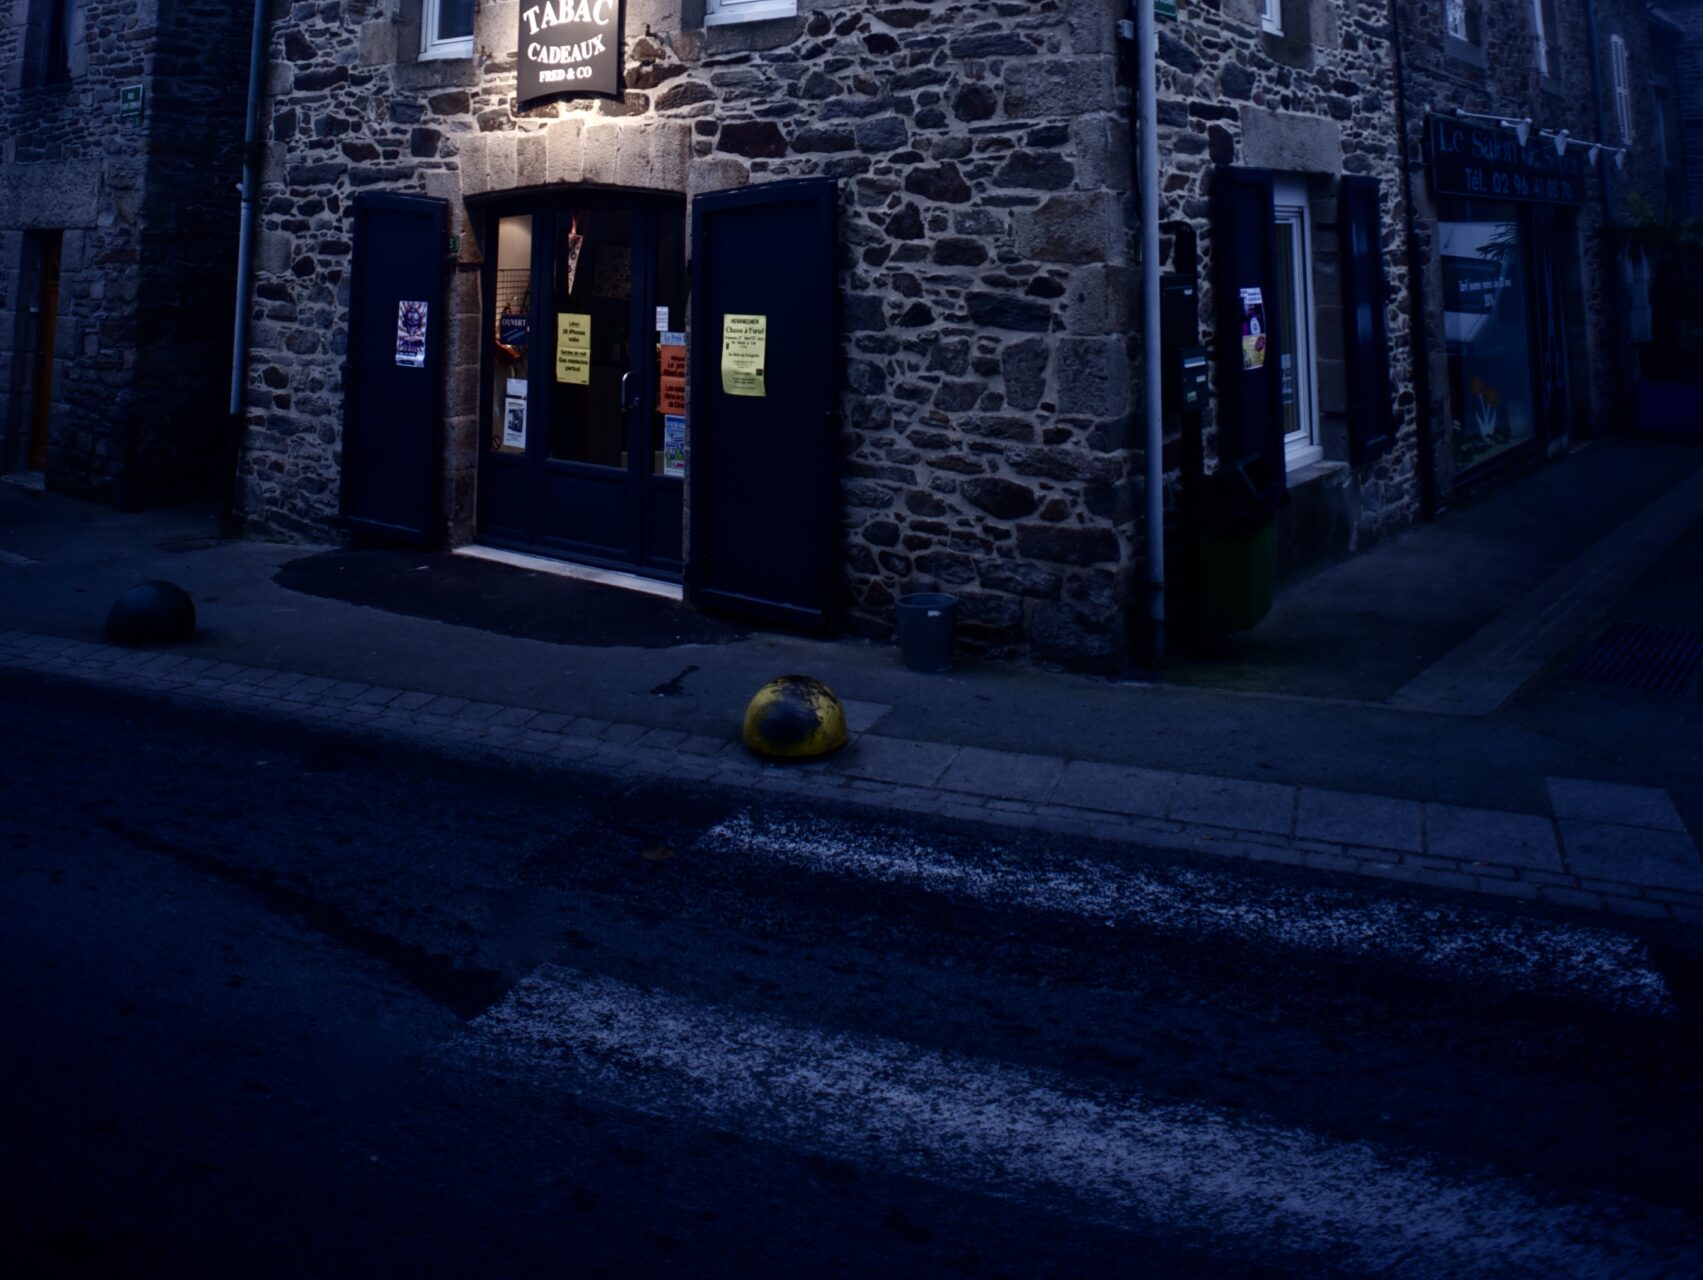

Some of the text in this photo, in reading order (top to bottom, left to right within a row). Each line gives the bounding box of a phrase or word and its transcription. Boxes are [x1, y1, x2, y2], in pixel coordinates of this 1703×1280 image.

[527, 33, 607, 65] CADEAUX
[539, 66, 593, 83] FRED & CO
[1439, 122, 1463, 154] Le
[1471, 129, 1517, 164] Salon
[1464, 167, 1487, 193] Tél.
[1492, 172, 1509, 195] 02
[1513, 174, 1529, 197] 96
[502, 318, 526, 327] OUVERT
